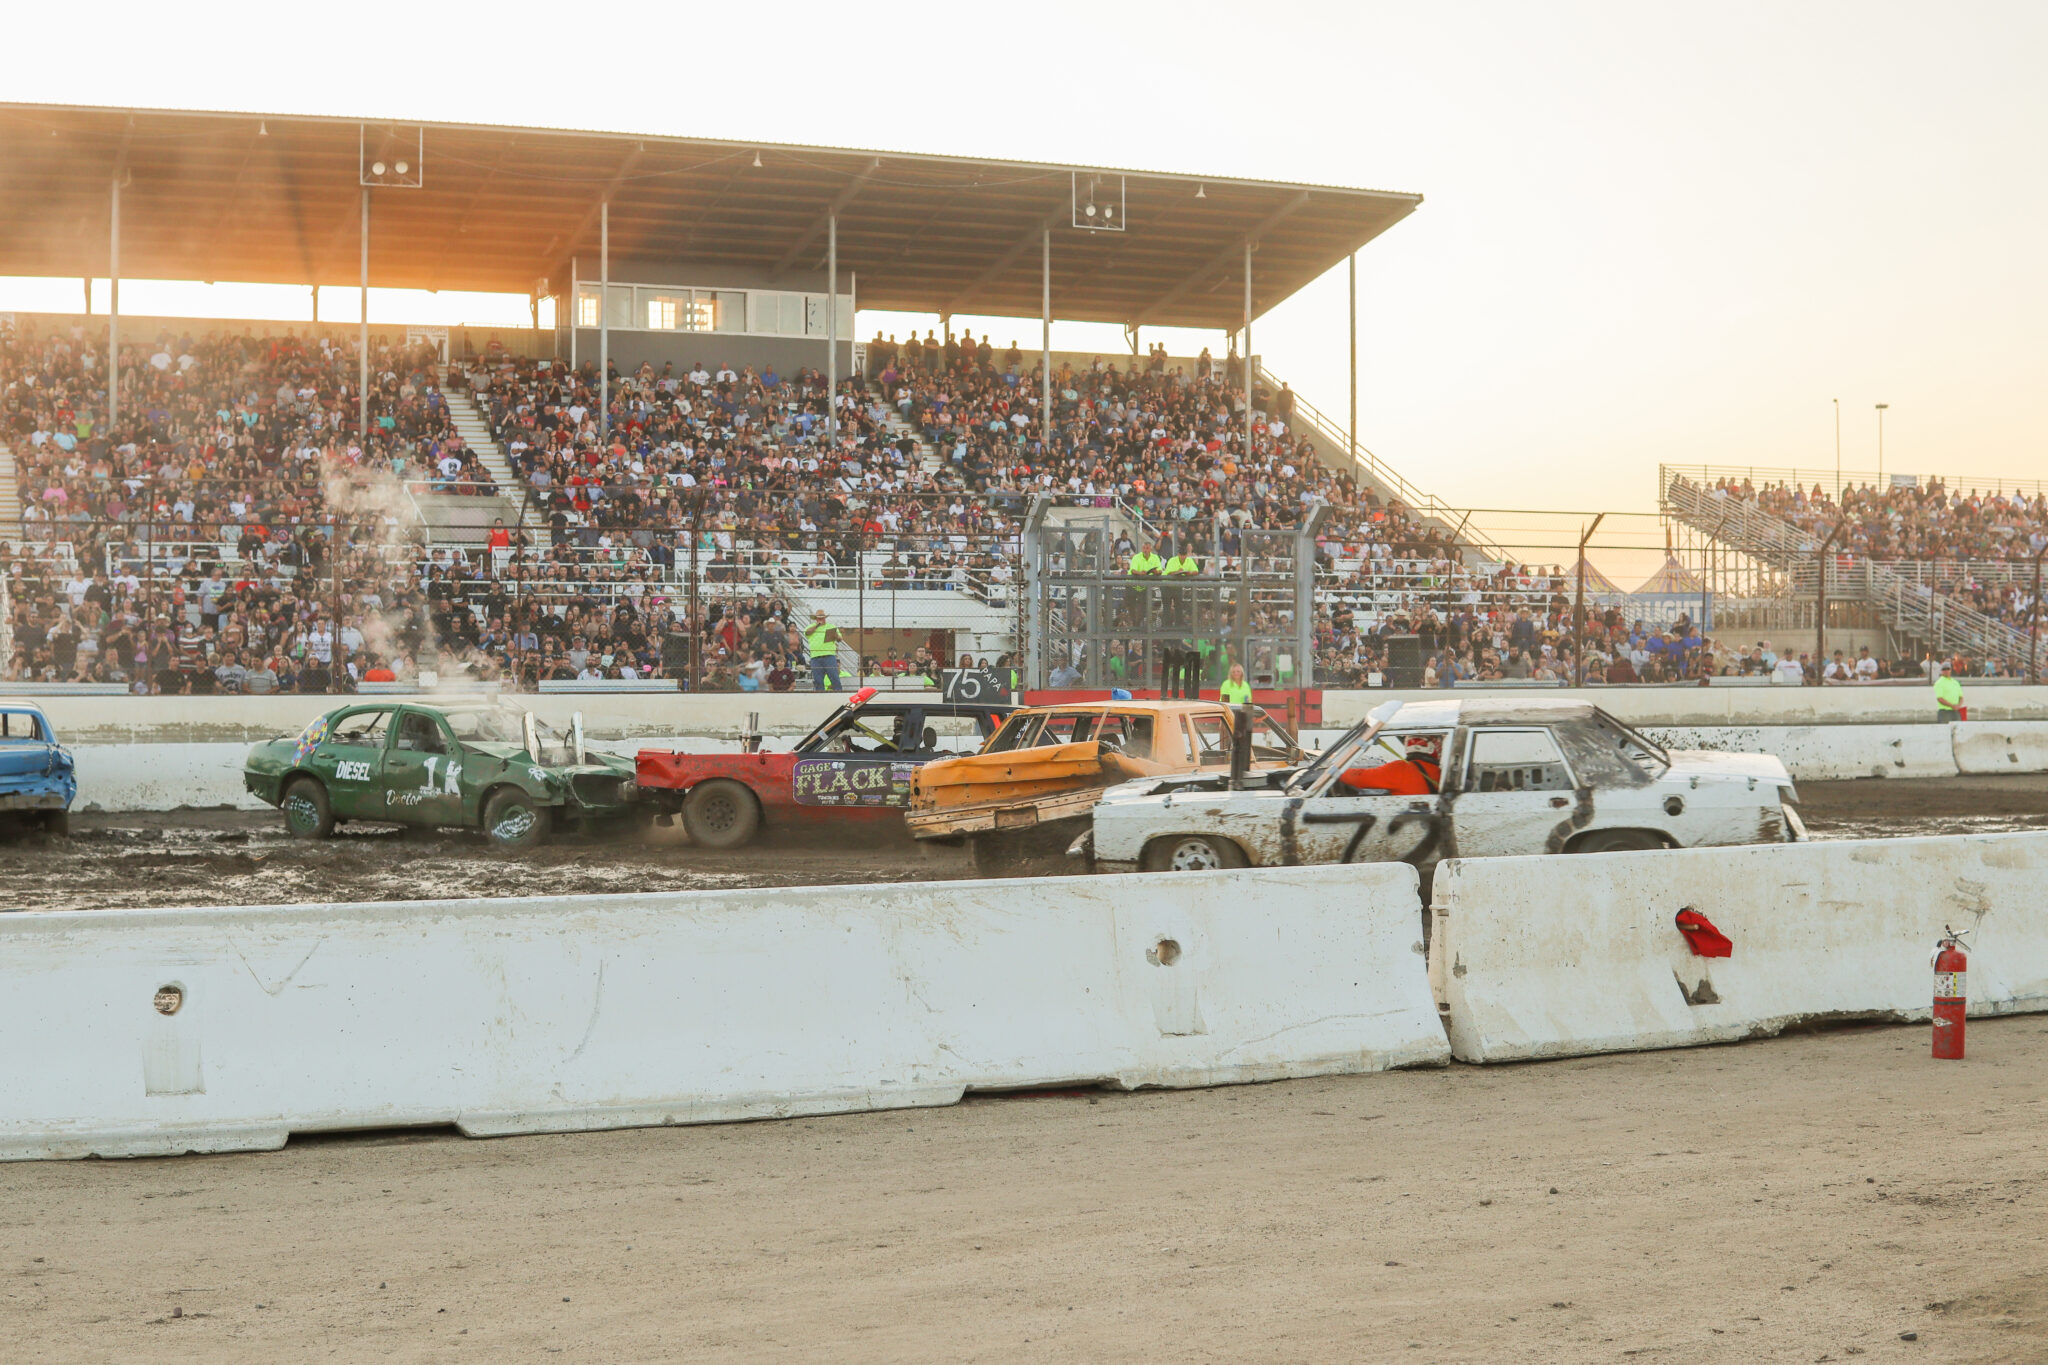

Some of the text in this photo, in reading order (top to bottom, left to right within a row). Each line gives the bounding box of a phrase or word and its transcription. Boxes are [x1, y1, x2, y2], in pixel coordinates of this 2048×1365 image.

[943, 668, 981, 699] 75
[980, 667, 1001, 692] PAPA
[336, 761, 370, 781] DIESEL
[800, 762, 831, 774] GAGE
[796, 766, 887, 796] FLACK
